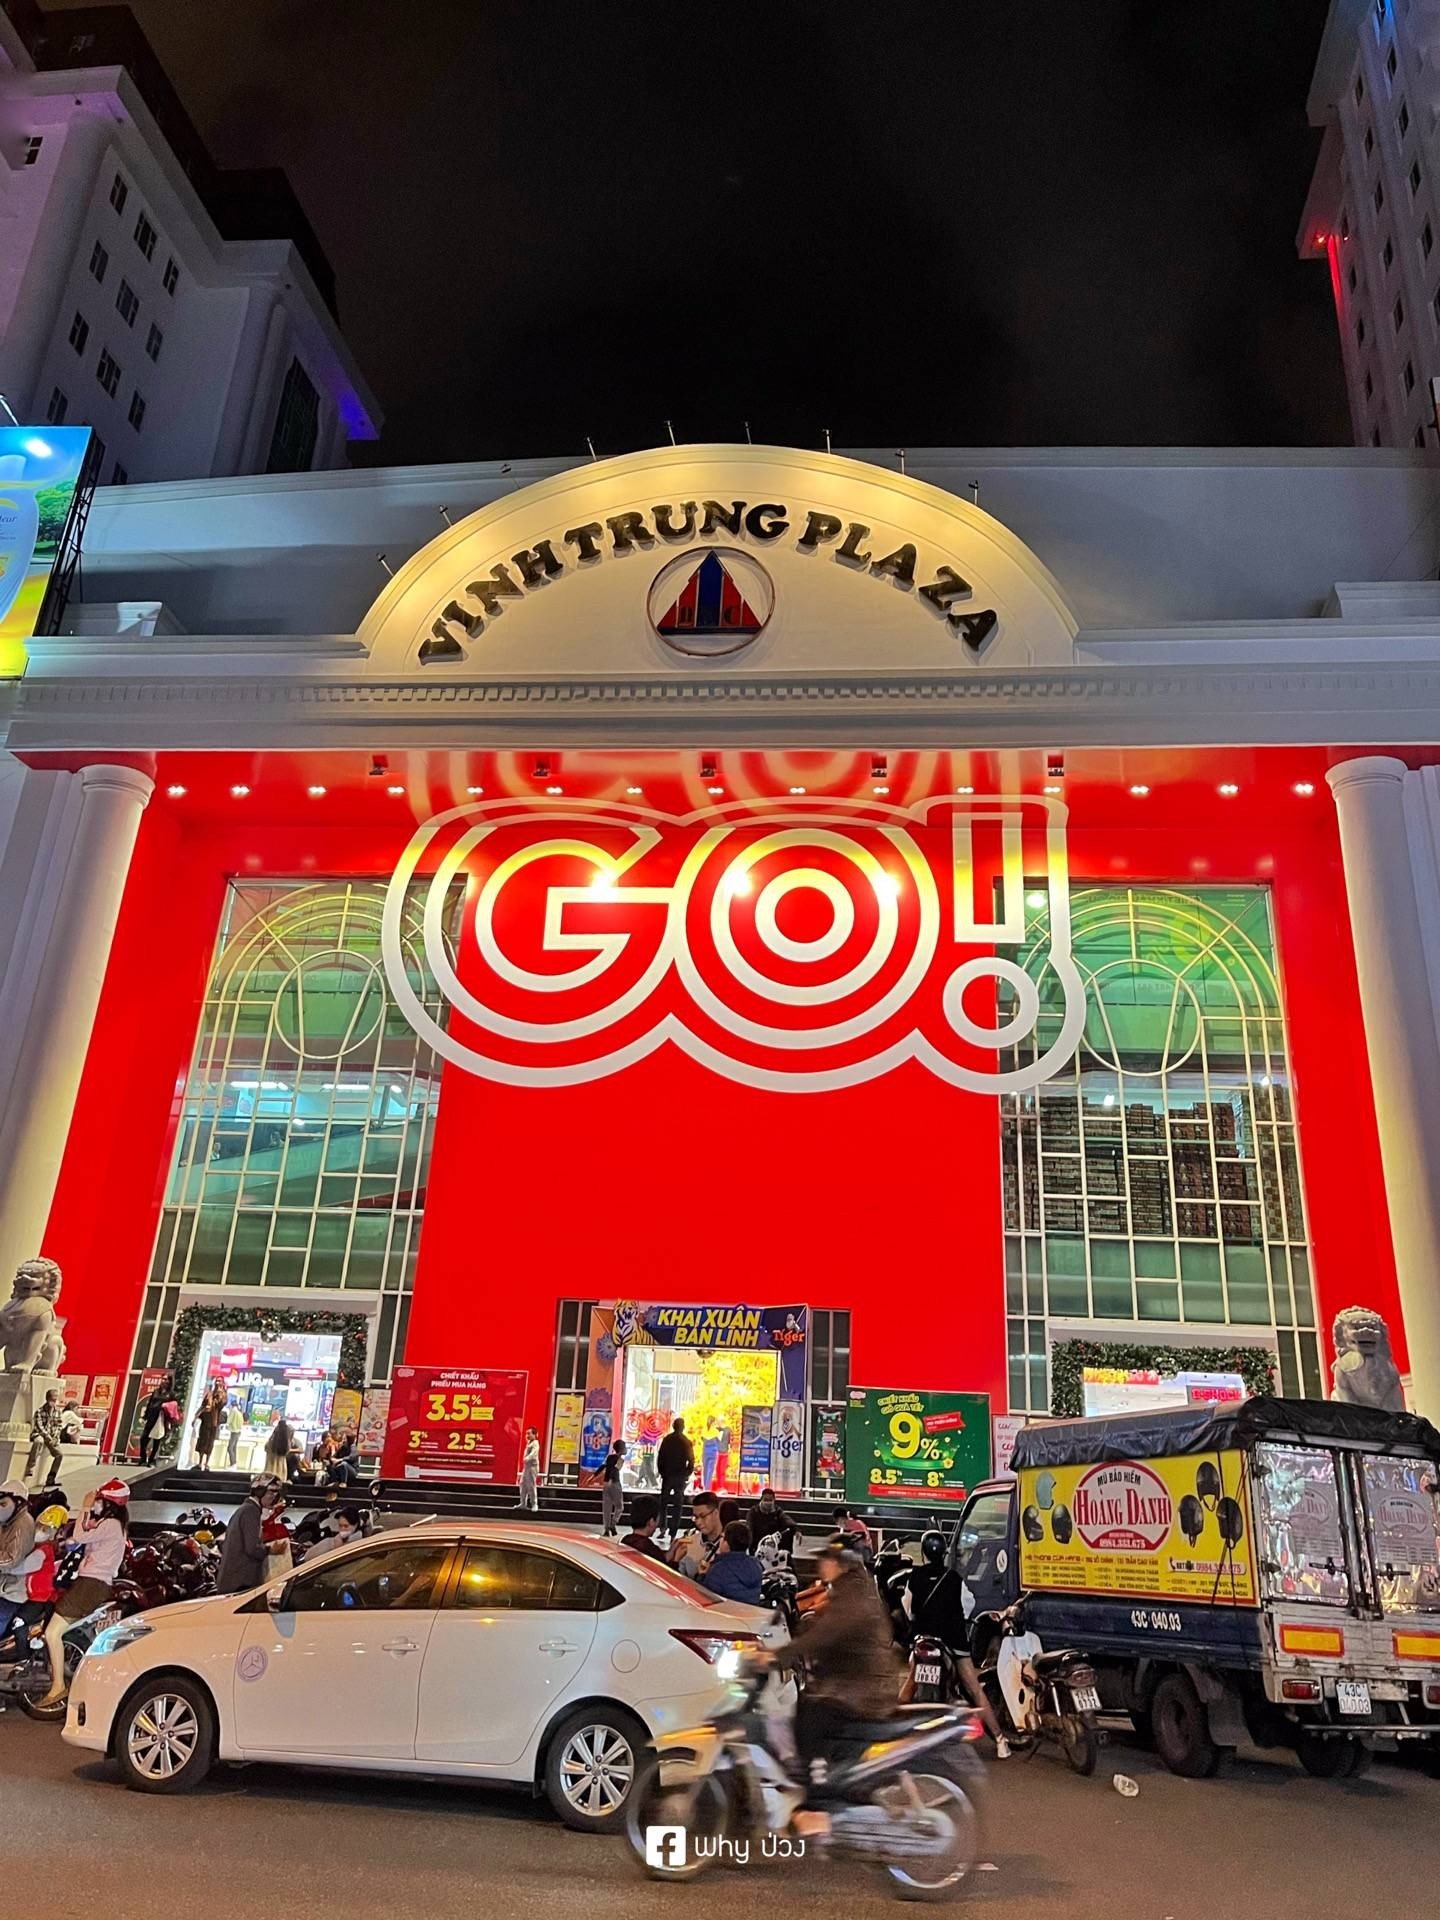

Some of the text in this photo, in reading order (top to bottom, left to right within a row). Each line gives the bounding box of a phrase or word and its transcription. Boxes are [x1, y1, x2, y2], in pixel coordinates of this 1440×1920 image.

[418, 499, 999, 664] VINH TRUNG PLAZA
[383, 794, 1085, 1095] GO!
[656, 1305, 762, 1329] KHAI XUÂN
[772, 1328, 806, 1346] Tiger
[425, 1393, 483, 1421] 3.5%
[771, 1434, 804, 1459] Tiger
[889, 1411, 940, 1460] 9%
[1126, 1488, 1169, 1526] DANH
[1131, 1610, 1182, 1632] 43C 040.03
[1344, 1684, 1362, 1697] 43C
